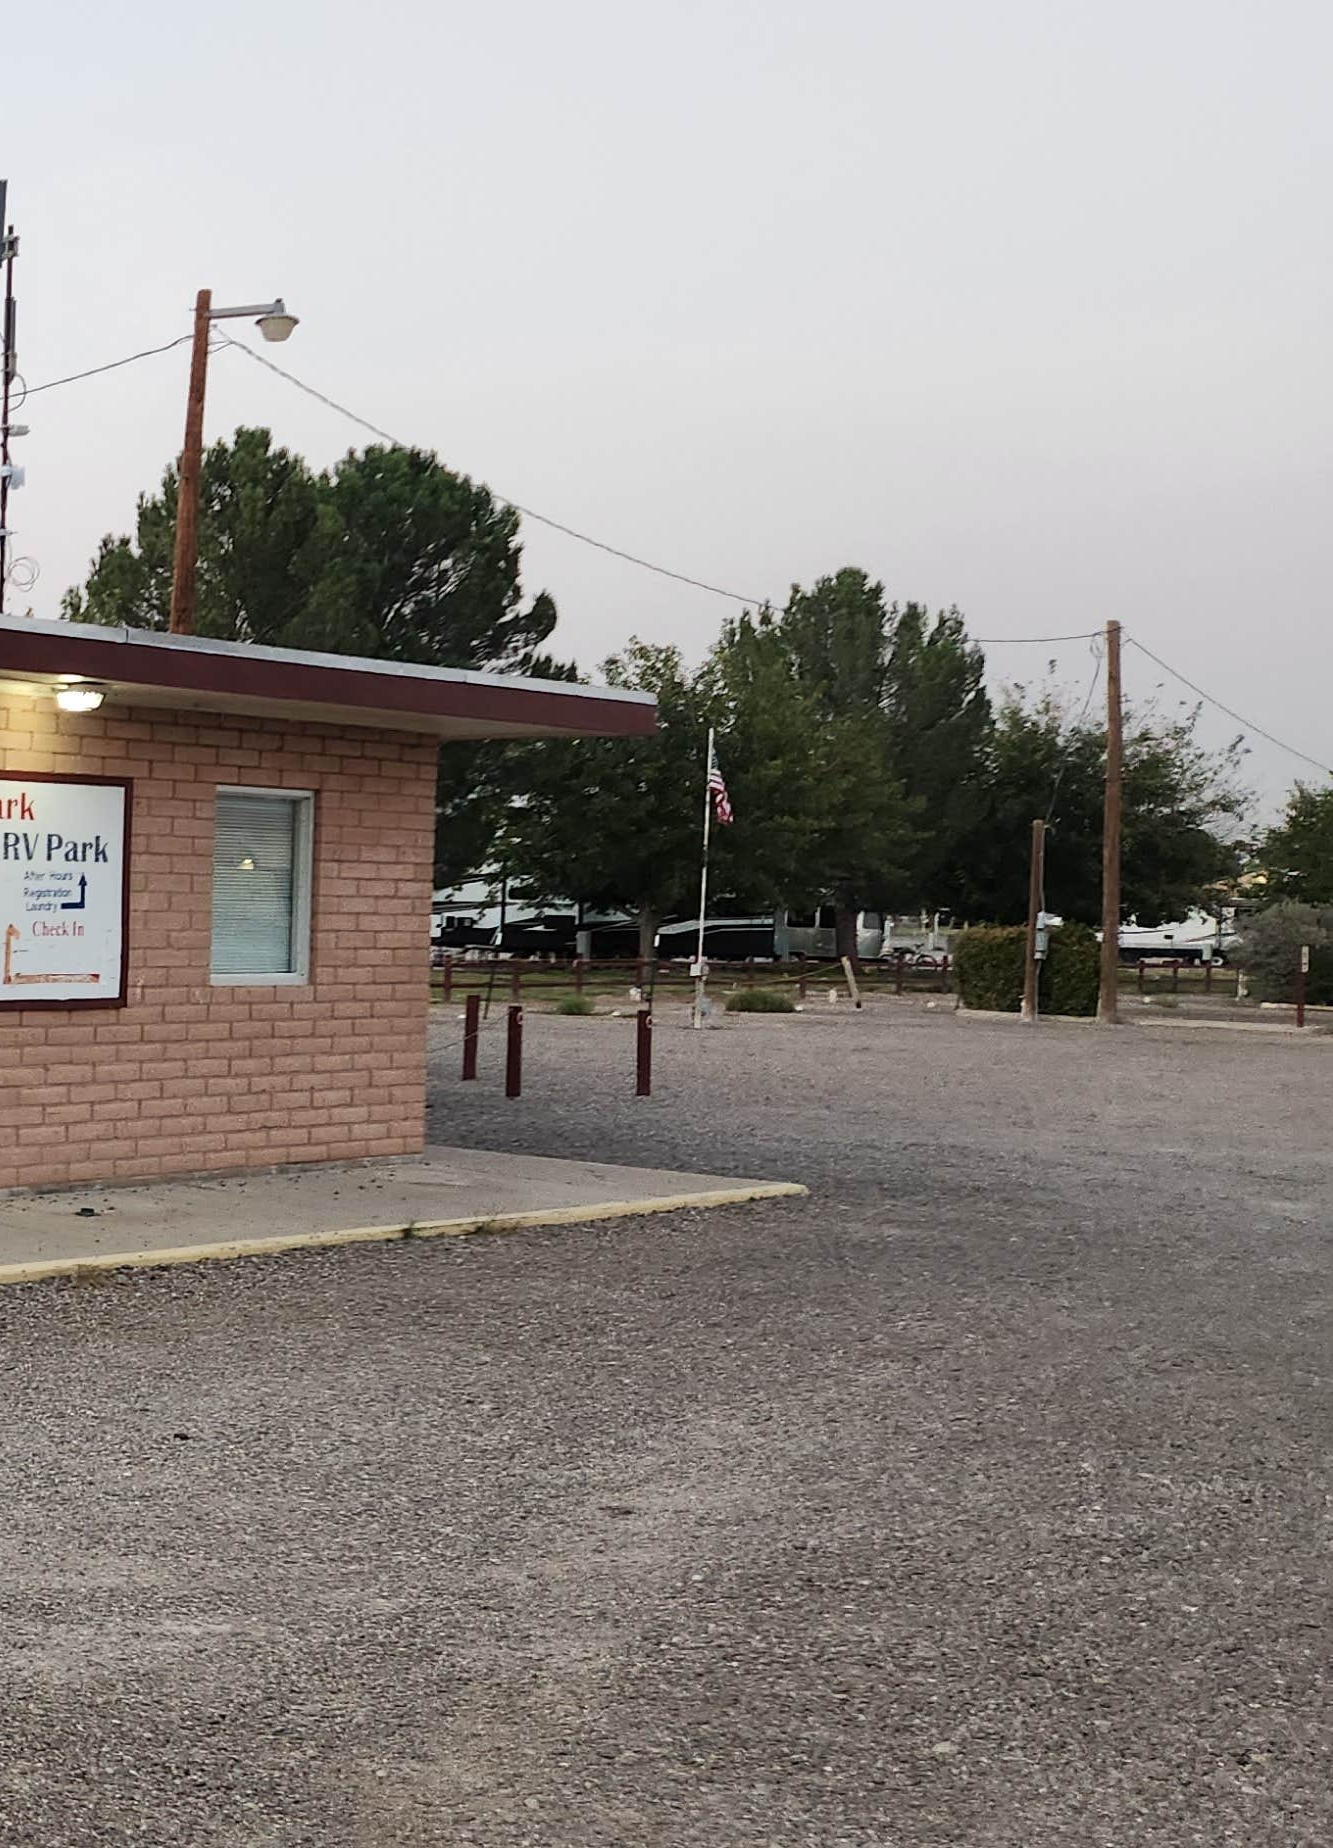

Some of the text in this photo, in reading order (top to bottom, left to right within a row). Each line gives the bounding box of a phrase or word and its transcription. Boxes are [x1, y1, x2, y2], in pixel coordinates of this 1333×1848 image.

[3, 832, 110, 863] RV Park
[32, 920, 85, 937] Check In
